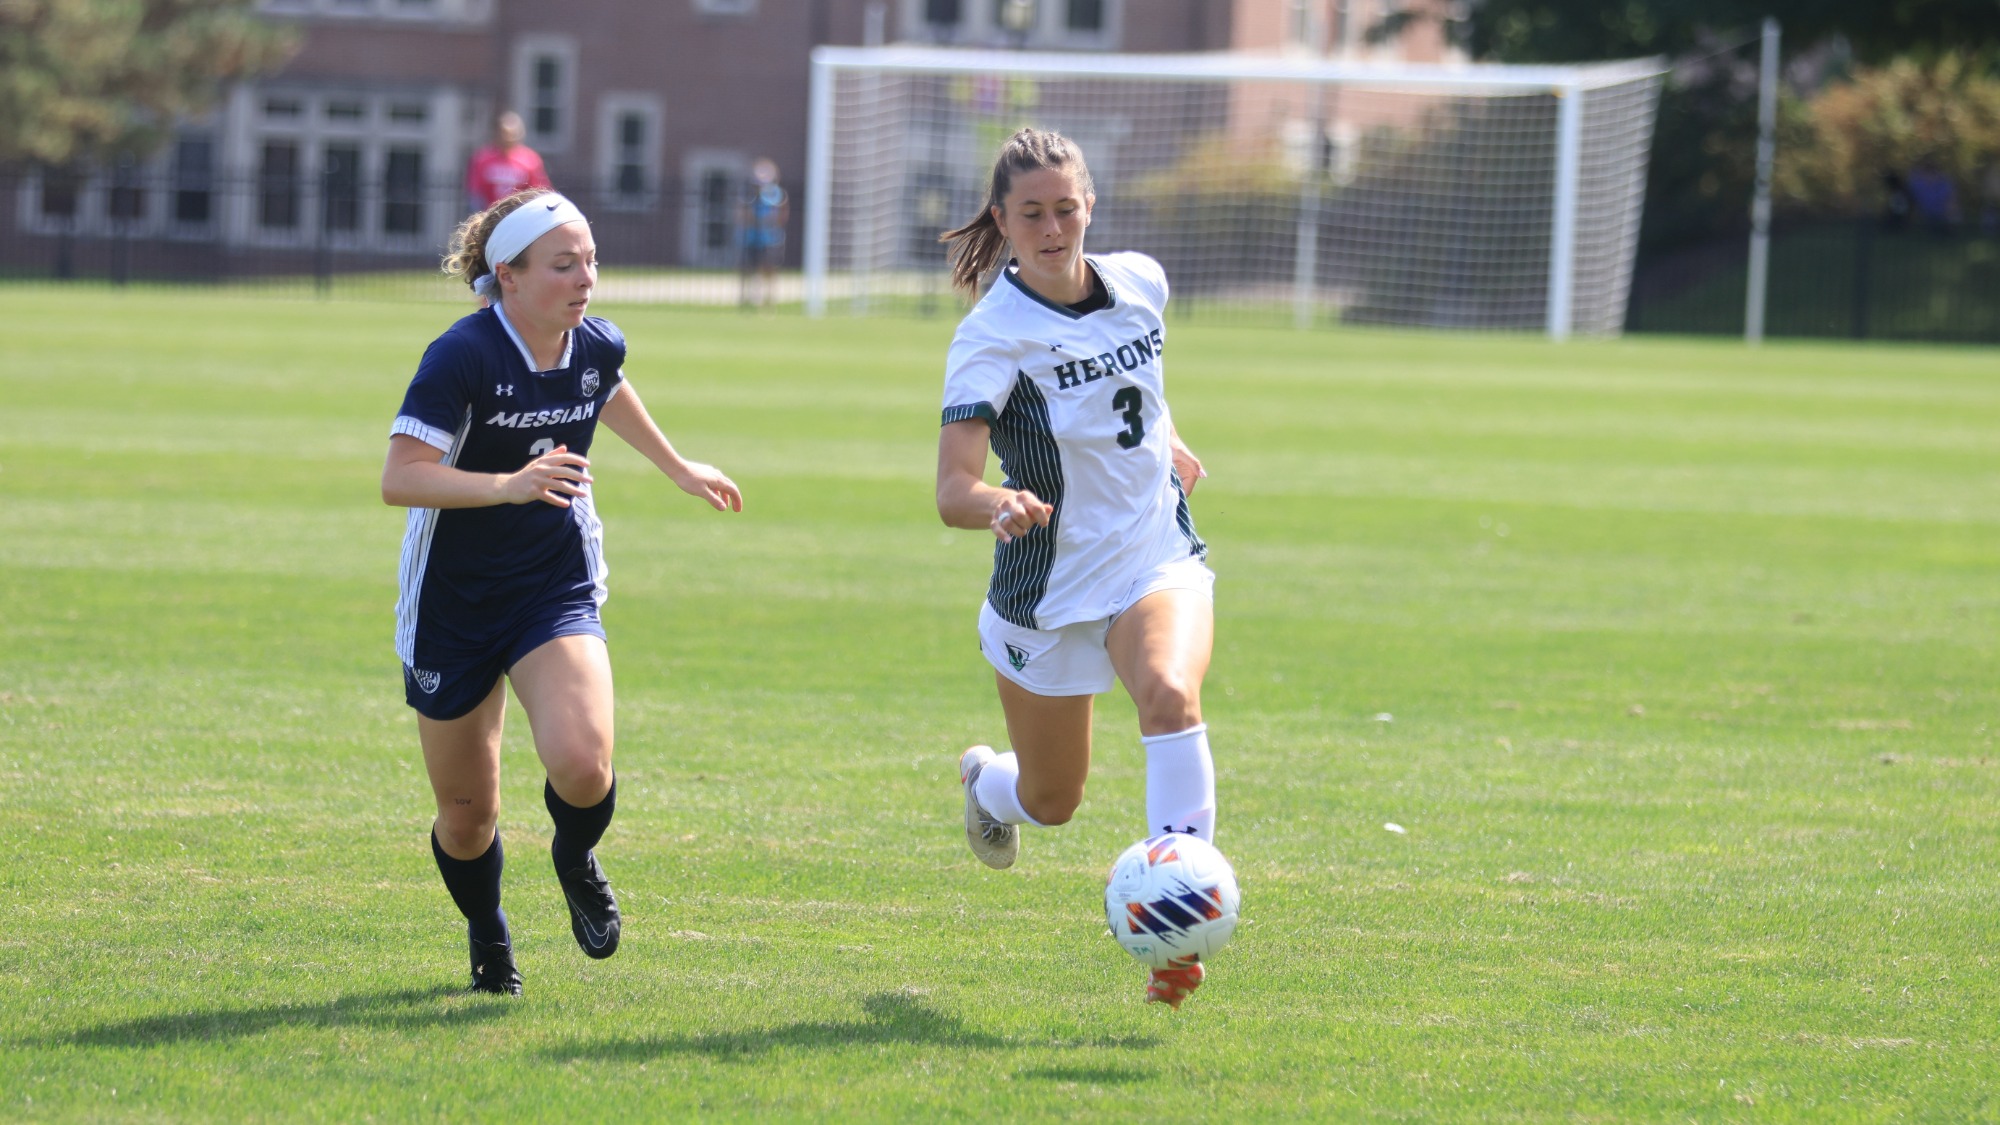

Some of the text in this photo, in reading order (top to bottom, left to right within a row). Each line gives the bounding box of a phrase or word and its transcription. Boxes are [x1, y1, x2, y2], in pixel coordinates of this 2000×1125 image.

[1053, 328, 1163, 391] HERONS
[485, 401, 595, 429] MESSIAH
[1112, 385, 1145, 450] 3
